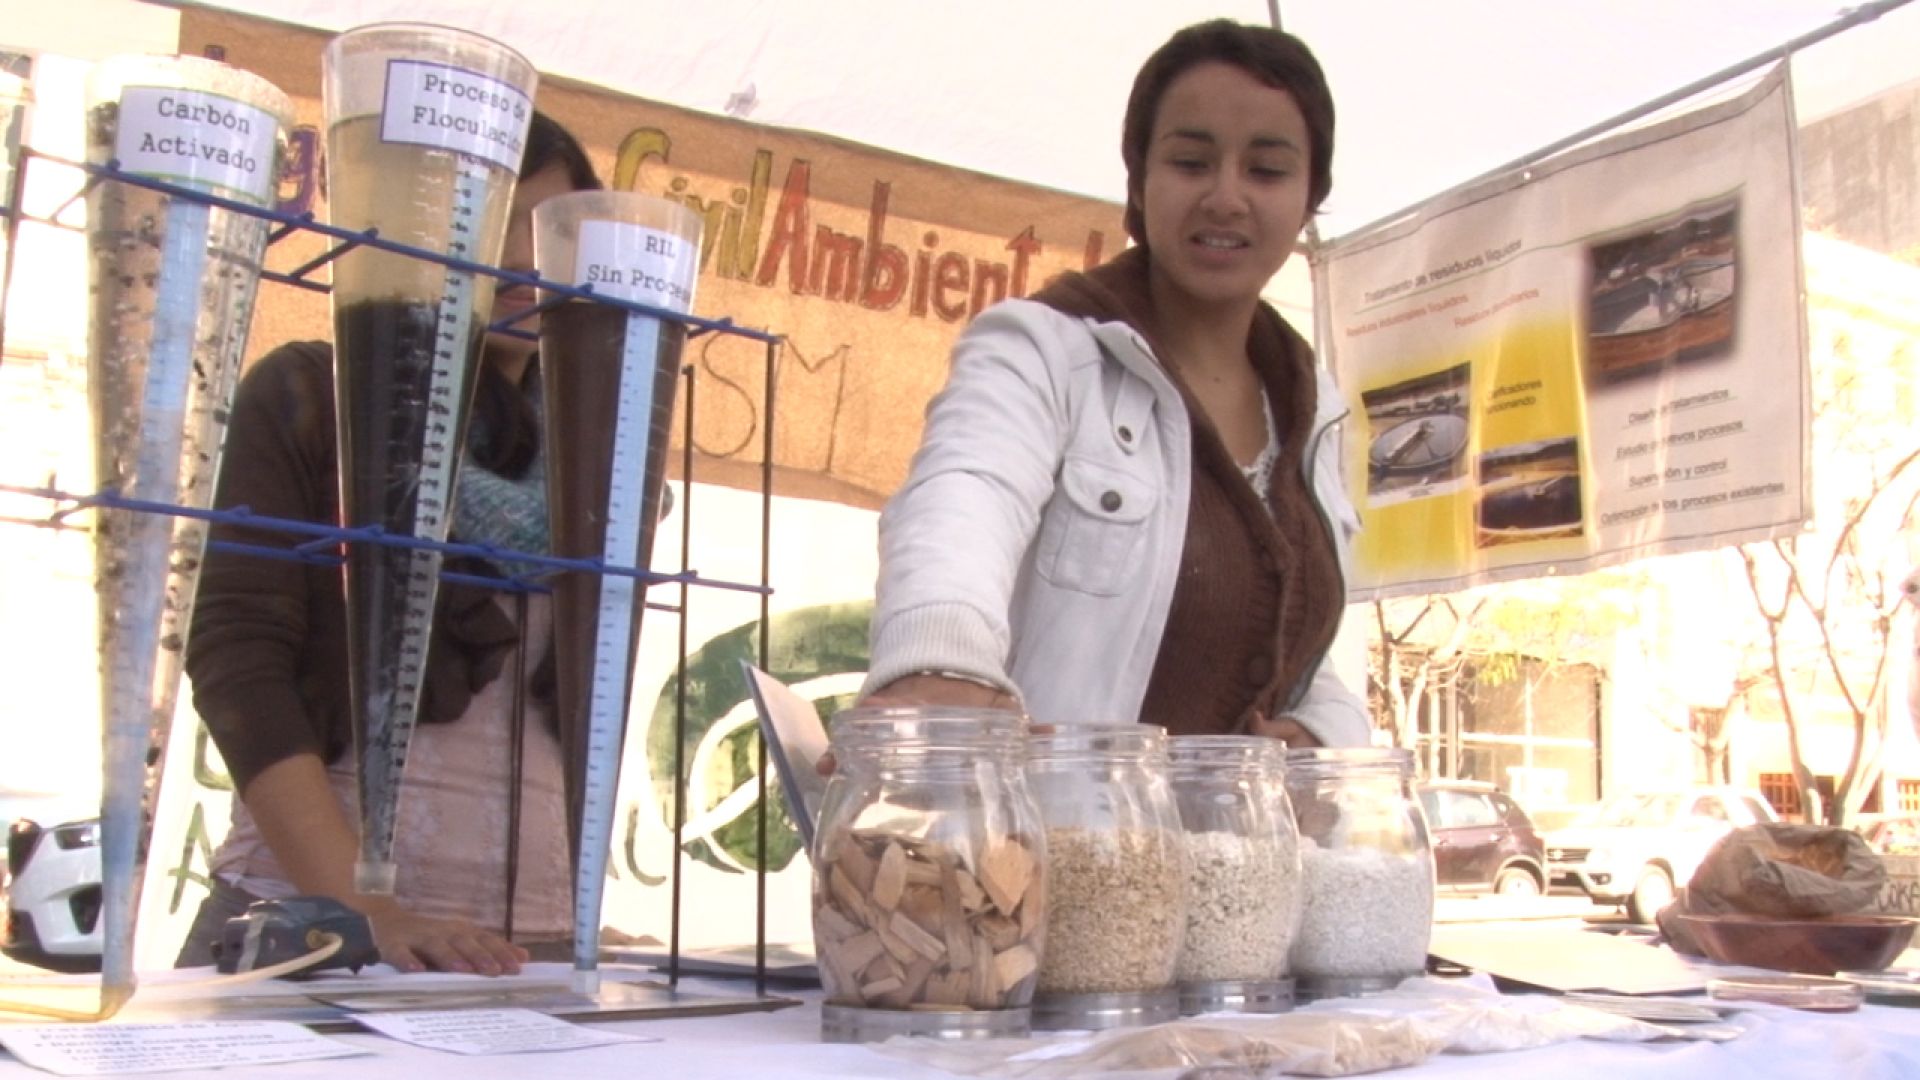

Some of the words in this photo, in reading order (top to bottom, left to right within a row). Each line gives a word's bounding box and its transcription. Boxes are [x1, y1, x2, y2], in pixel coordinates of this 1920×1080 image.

[423, 73, 510, 112] Proceso
[157, 96, 250, 135] Carbón
[140, 131, 257, 173] Activado
[645, 234, 676, 258] RIL
[587, 263, 622, 284] Sin
